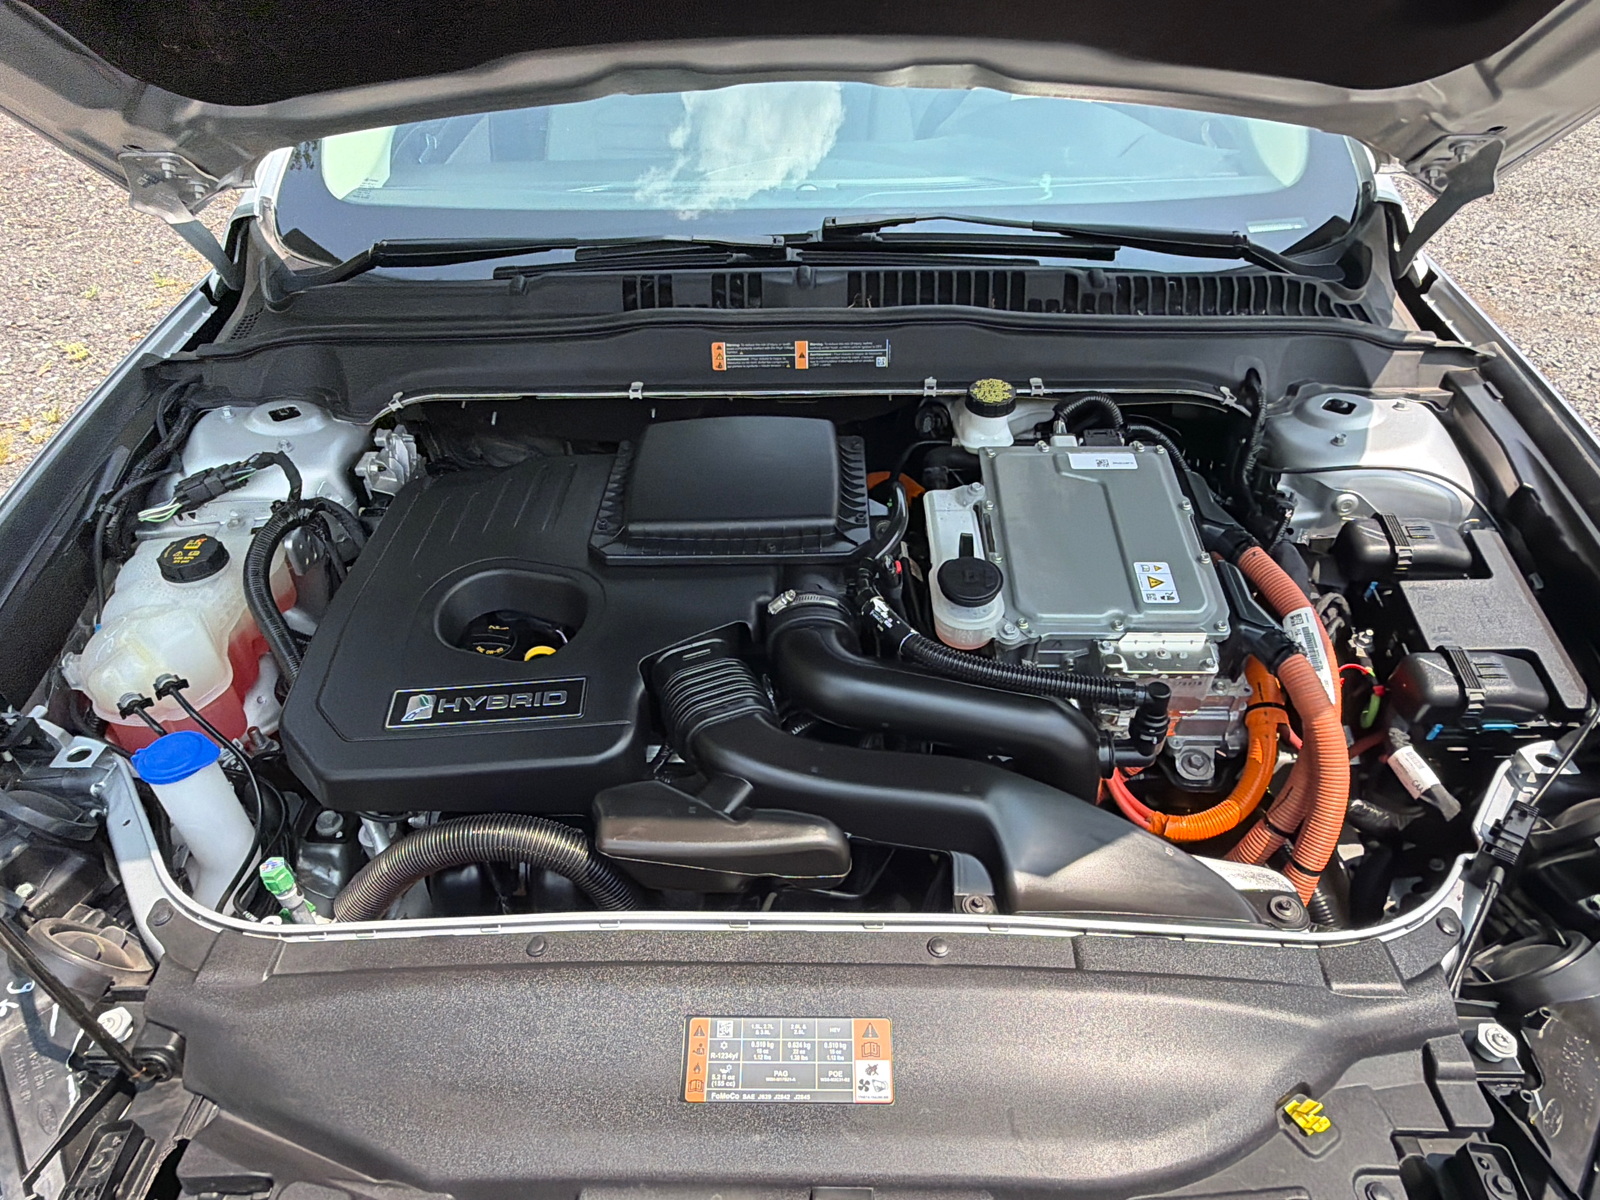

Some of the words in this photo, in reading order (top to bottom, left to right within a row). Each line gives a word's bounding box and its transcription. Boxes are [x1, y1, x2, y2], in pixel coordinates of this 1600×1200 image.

[437, 690, 568, 713] HYBRID
[766, 1041, 774, 1049] kg
[803, 1042, 811, 1050] kg
[839, 1042, 847, 1050] kg
[710, 1052, 738, 1060] R-1234yf
[711, 1092, 740, 1100] FoMoCo
